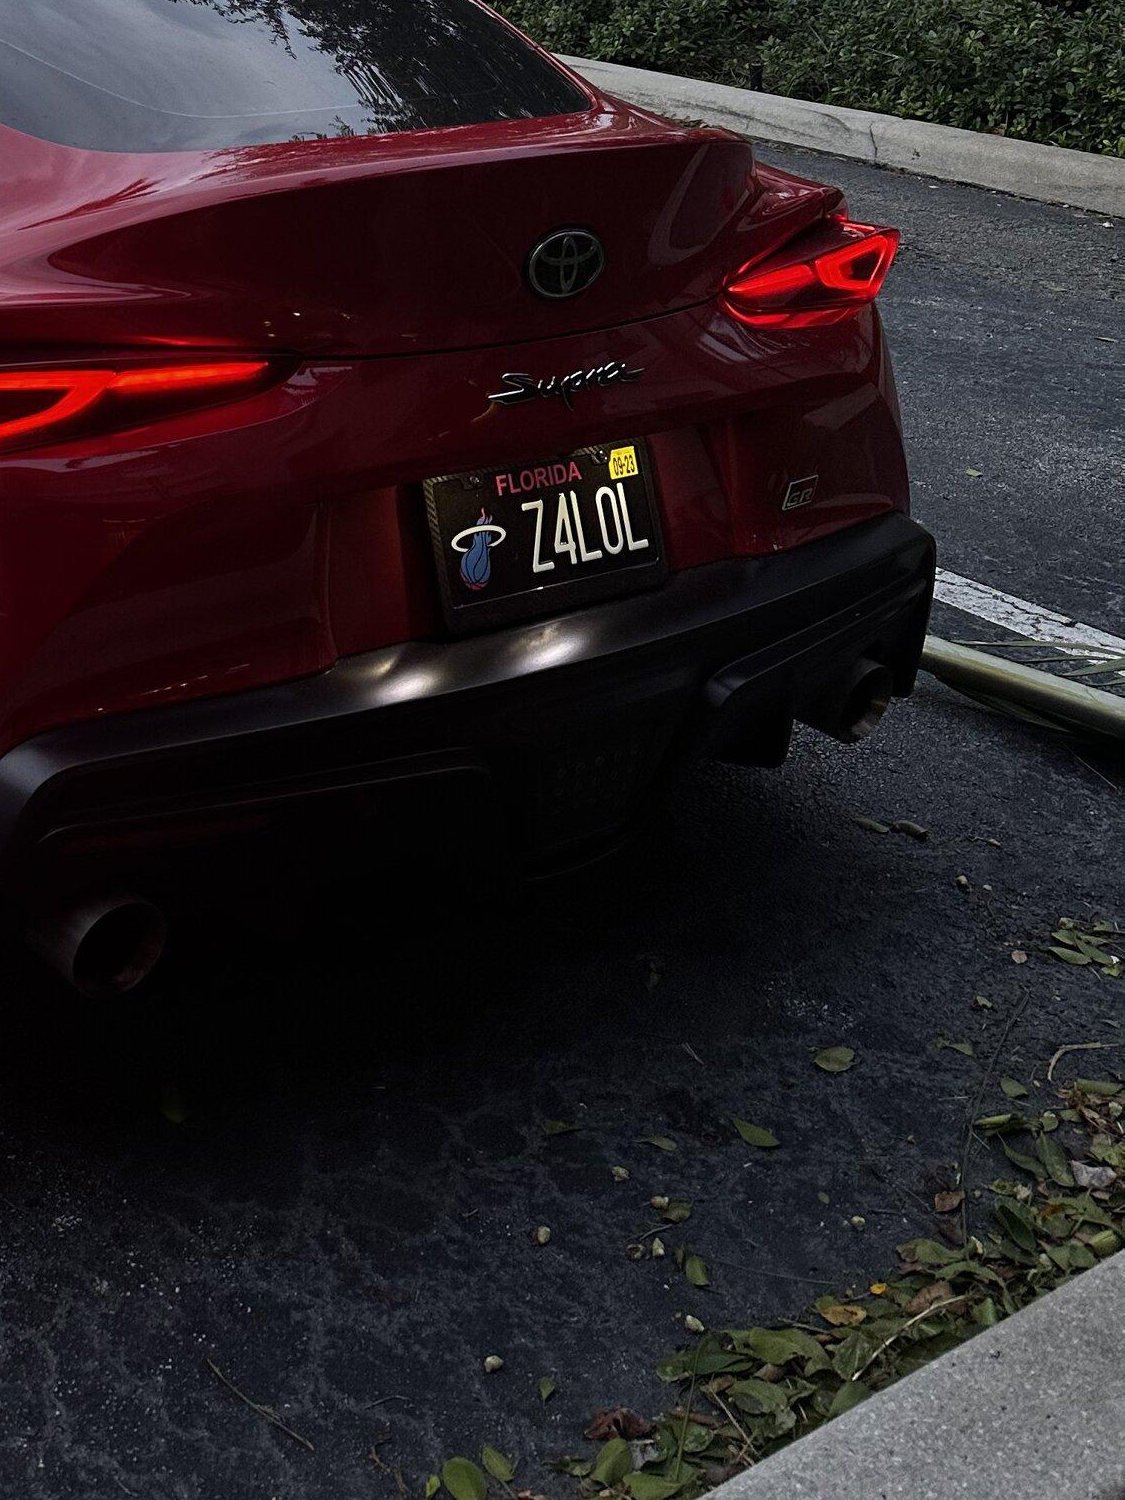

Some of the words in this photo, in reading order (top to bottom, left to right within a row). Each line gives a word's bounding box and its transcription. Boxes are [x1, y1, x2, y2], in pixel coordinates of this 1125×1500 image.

[487, 361, 645, 411] Supra
[495, 462, 582, 497] FLORIDA
[521, 482, 650, 573] Z4LOL
